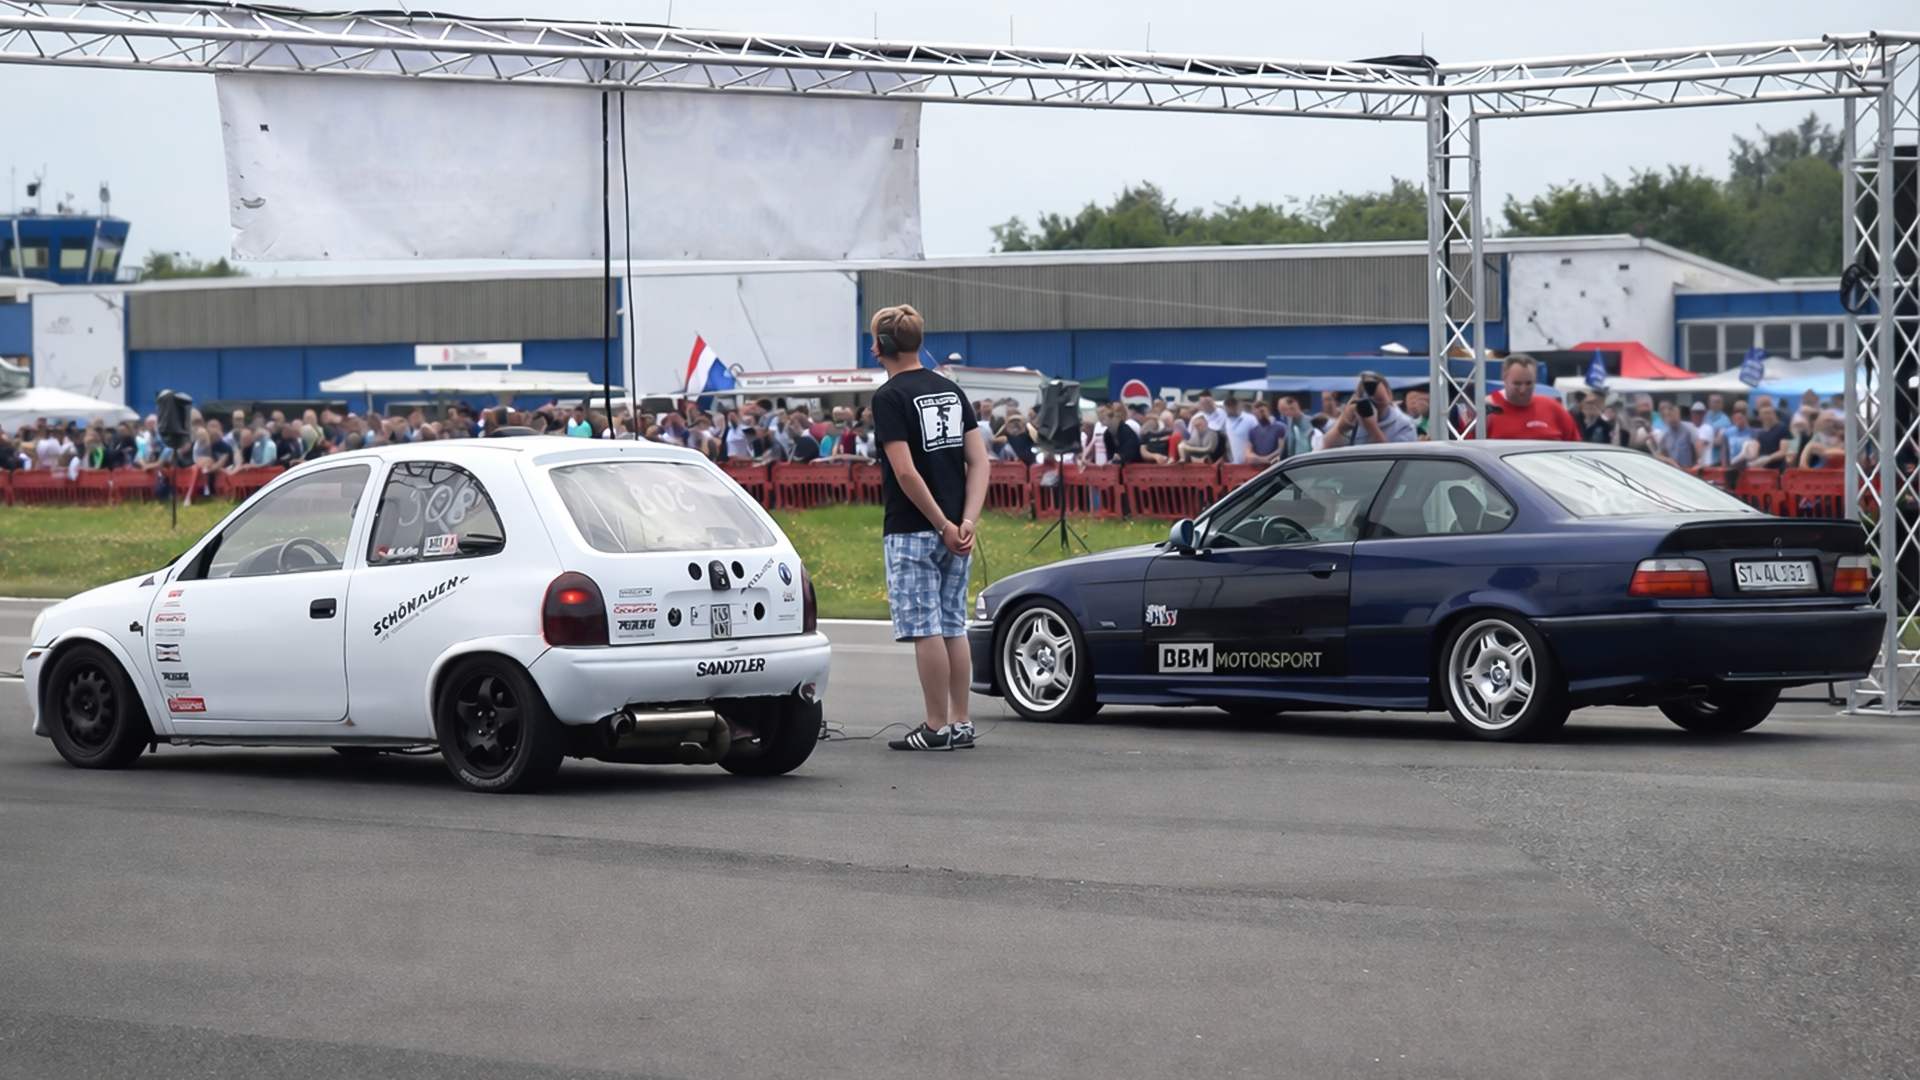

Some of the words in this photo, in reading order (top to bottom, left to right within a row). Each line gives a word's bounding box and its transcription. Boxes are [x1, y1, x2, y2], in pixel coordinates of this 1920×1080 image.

[696, 657, 766, 677] SANDTLER
[1163, 648, 1209, 668] BBM
[1215, 652, 1322, 668] MOTORSPORT
